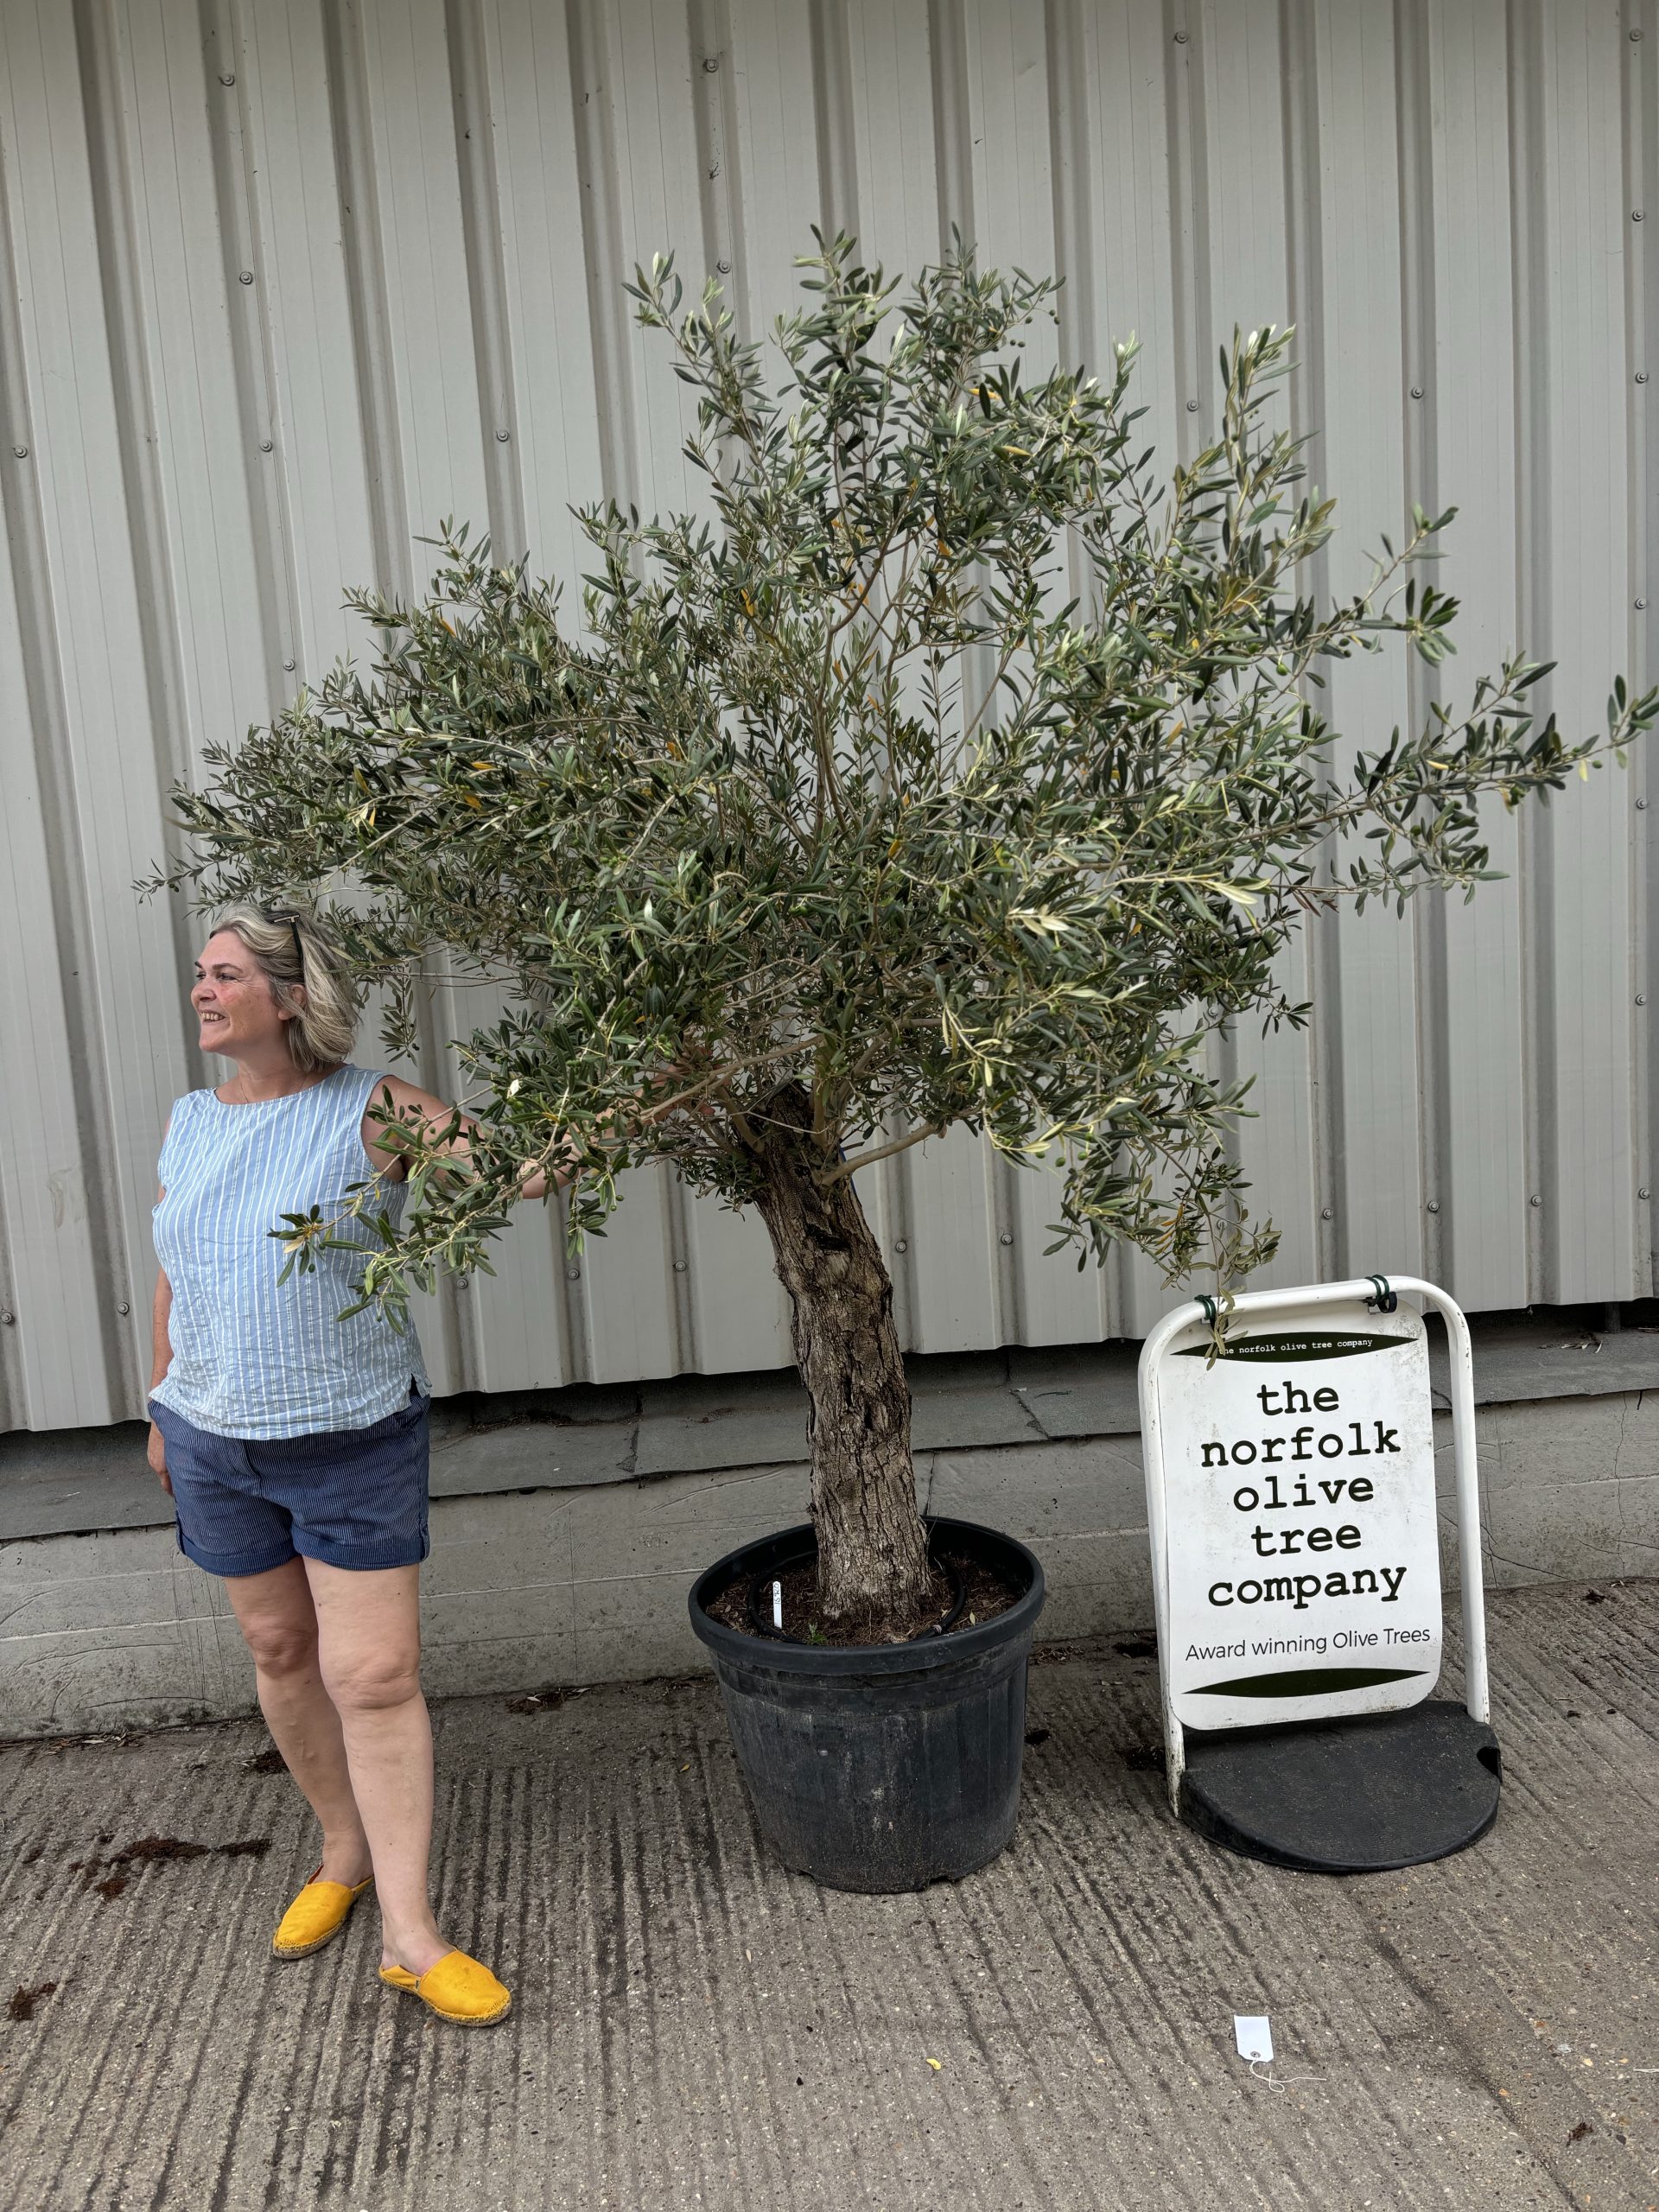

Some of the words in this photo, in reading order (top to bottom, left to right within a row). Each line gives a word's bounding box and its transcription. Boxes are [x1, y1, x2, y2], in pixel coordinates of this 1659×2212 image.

[1238, 1344, 1276, 1354] norfolk
[1281, 1342, 1307, 1351] olive
[1337, 1339, 1373, 1348] company
[1256, 1381, 1339, 1416] the
[1200, 1421, 1402, 1468] norfolk
[1233, 1473, 1374, 1512] olive
[1250, 1524, 1362, 1557] tree
[1208, 1567, 1408, 1610] company
[1185, 1639, 1246, 1662] Award
[1251, 1637, 1327, 1656] winning
[1332, 1630, 1379, 1649] Olive
[1382, 1628, 1431, 1645] Trees
